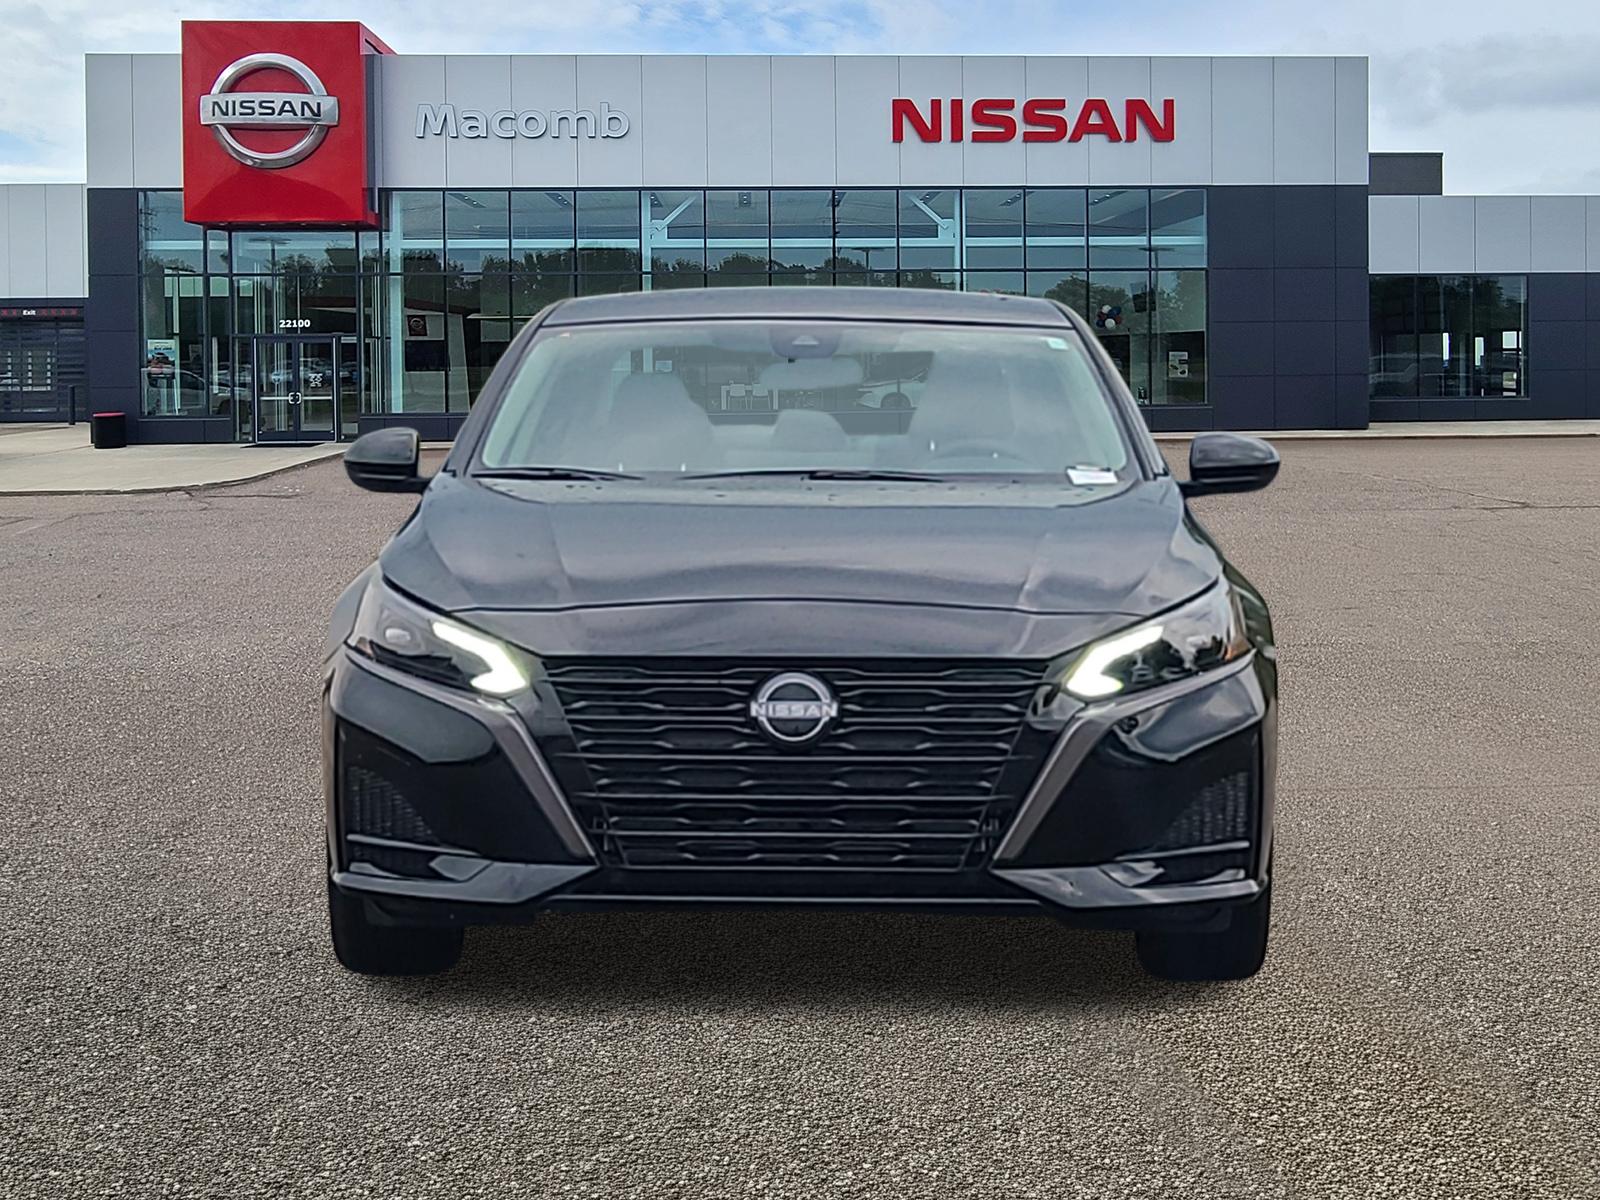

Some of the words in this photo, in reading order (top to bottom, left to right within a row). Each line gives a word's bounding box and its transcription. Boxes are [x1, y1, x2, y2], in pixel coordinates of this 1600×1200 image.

[211, 99, 322, 118] NISSAN
[415, 102, 630, 139] Macomb
[891, 98, 1175, 143] NISSAN
[279, 319, 311, 328] 22100
[750, 700, 838, 718] NISSAN
